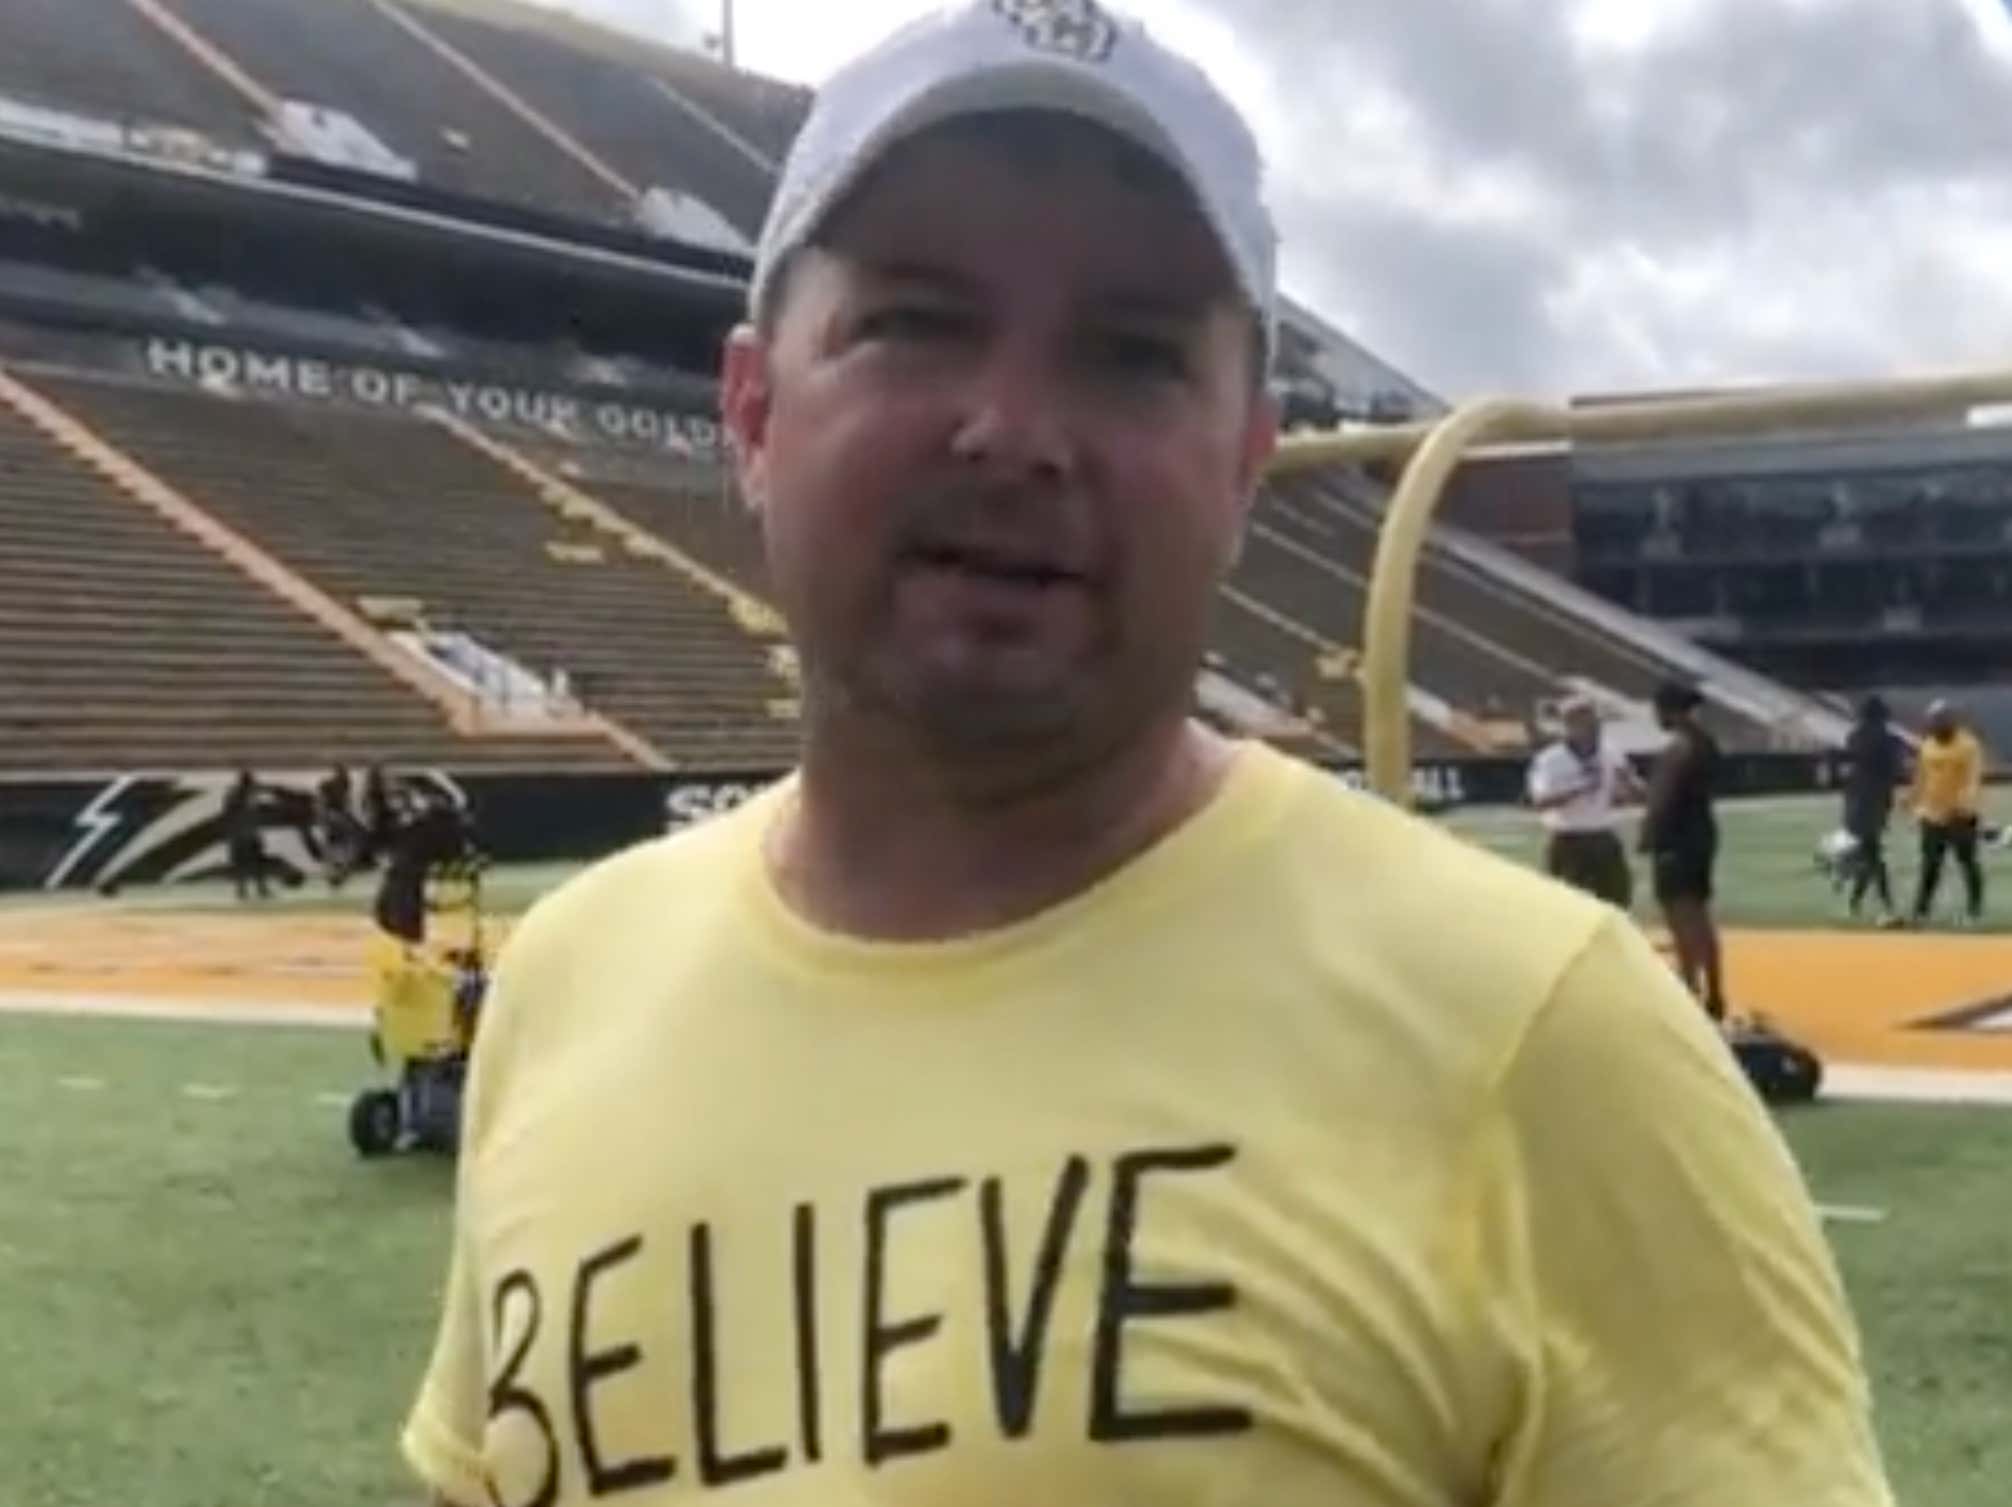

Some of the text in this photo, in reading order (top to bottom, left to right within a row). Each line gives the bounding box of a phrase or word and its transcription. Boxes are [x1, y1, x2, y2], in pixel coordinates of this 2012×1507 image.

[149, 336, 736, 456] HOME OF YOUR GOLD
[484, 1144, 1254, 1507] BELIEVE
